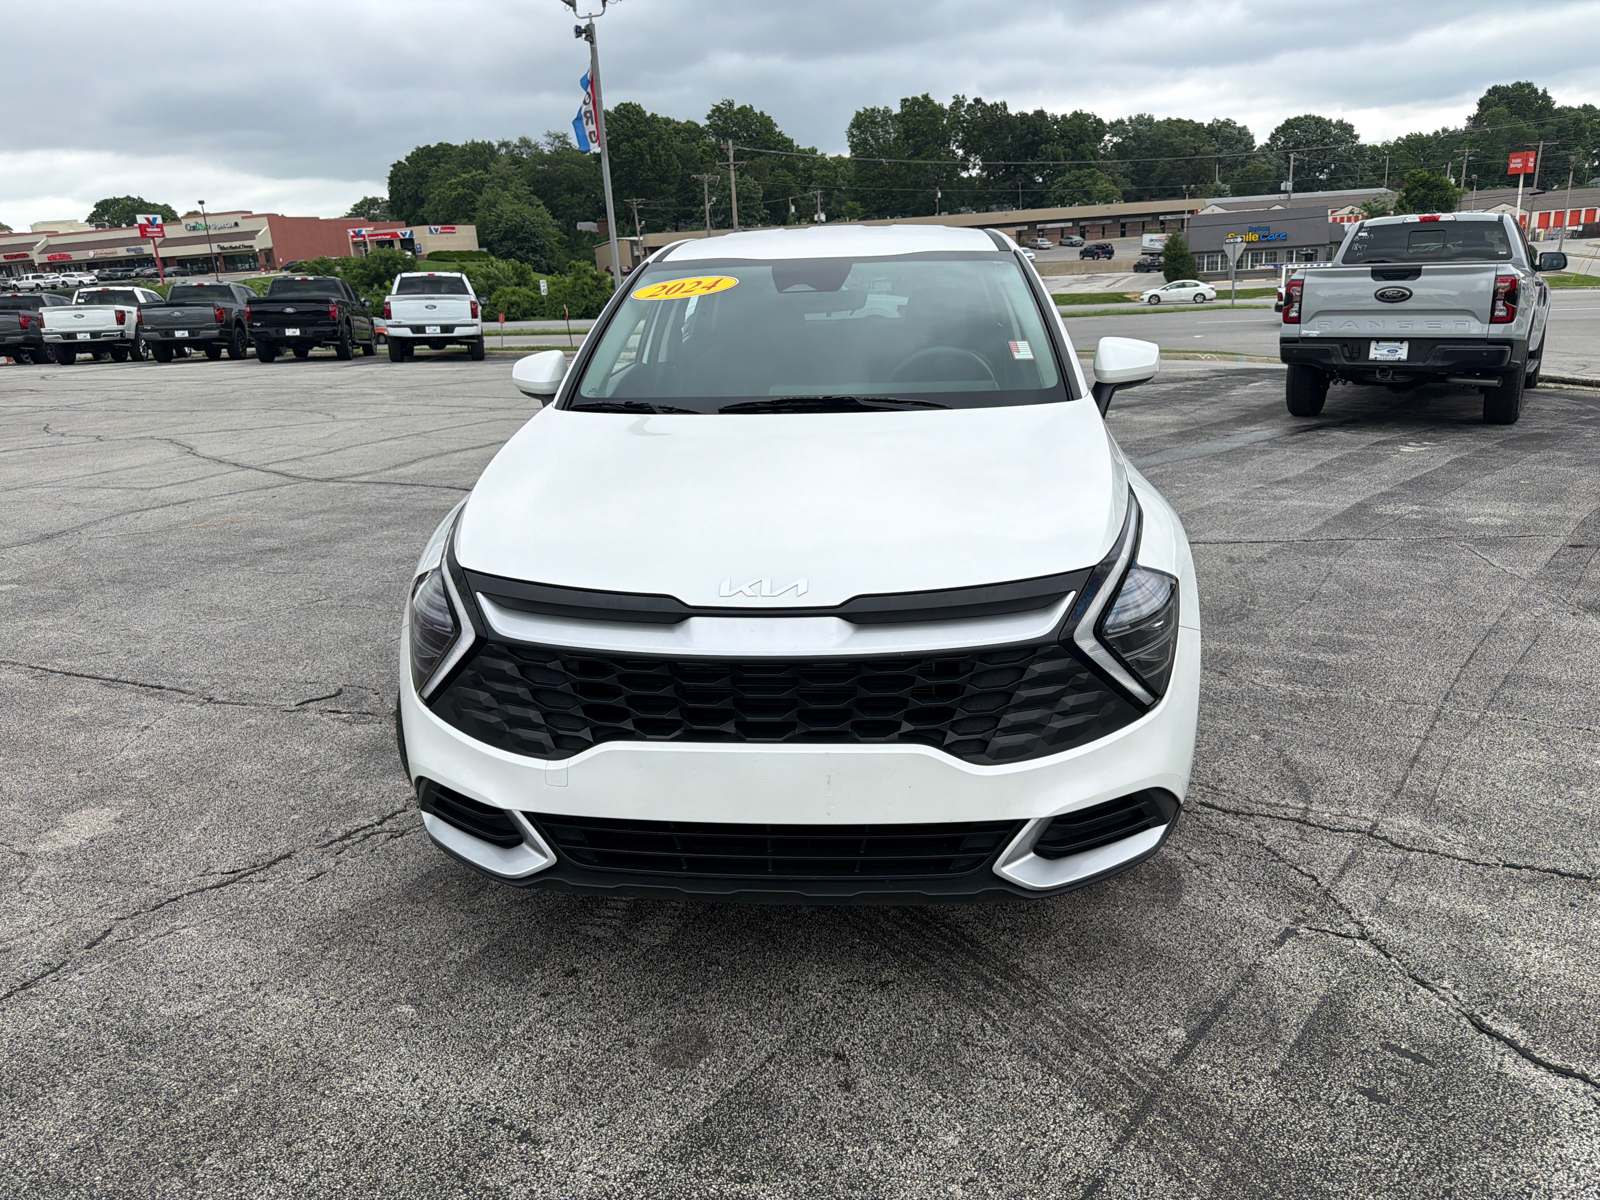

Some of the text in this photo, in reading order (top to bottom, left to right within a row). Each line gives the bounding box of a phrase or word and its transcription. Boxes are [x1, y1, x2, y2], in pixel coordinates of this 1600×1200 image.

[1260, 230, 1287, 241] Care
[1351, 243, 1367, 251] 1847
[645, 278, 724, 298] 2024
[1316, 320, 1471, 330] RANGER
[719, 578, 809, 598] KIA
